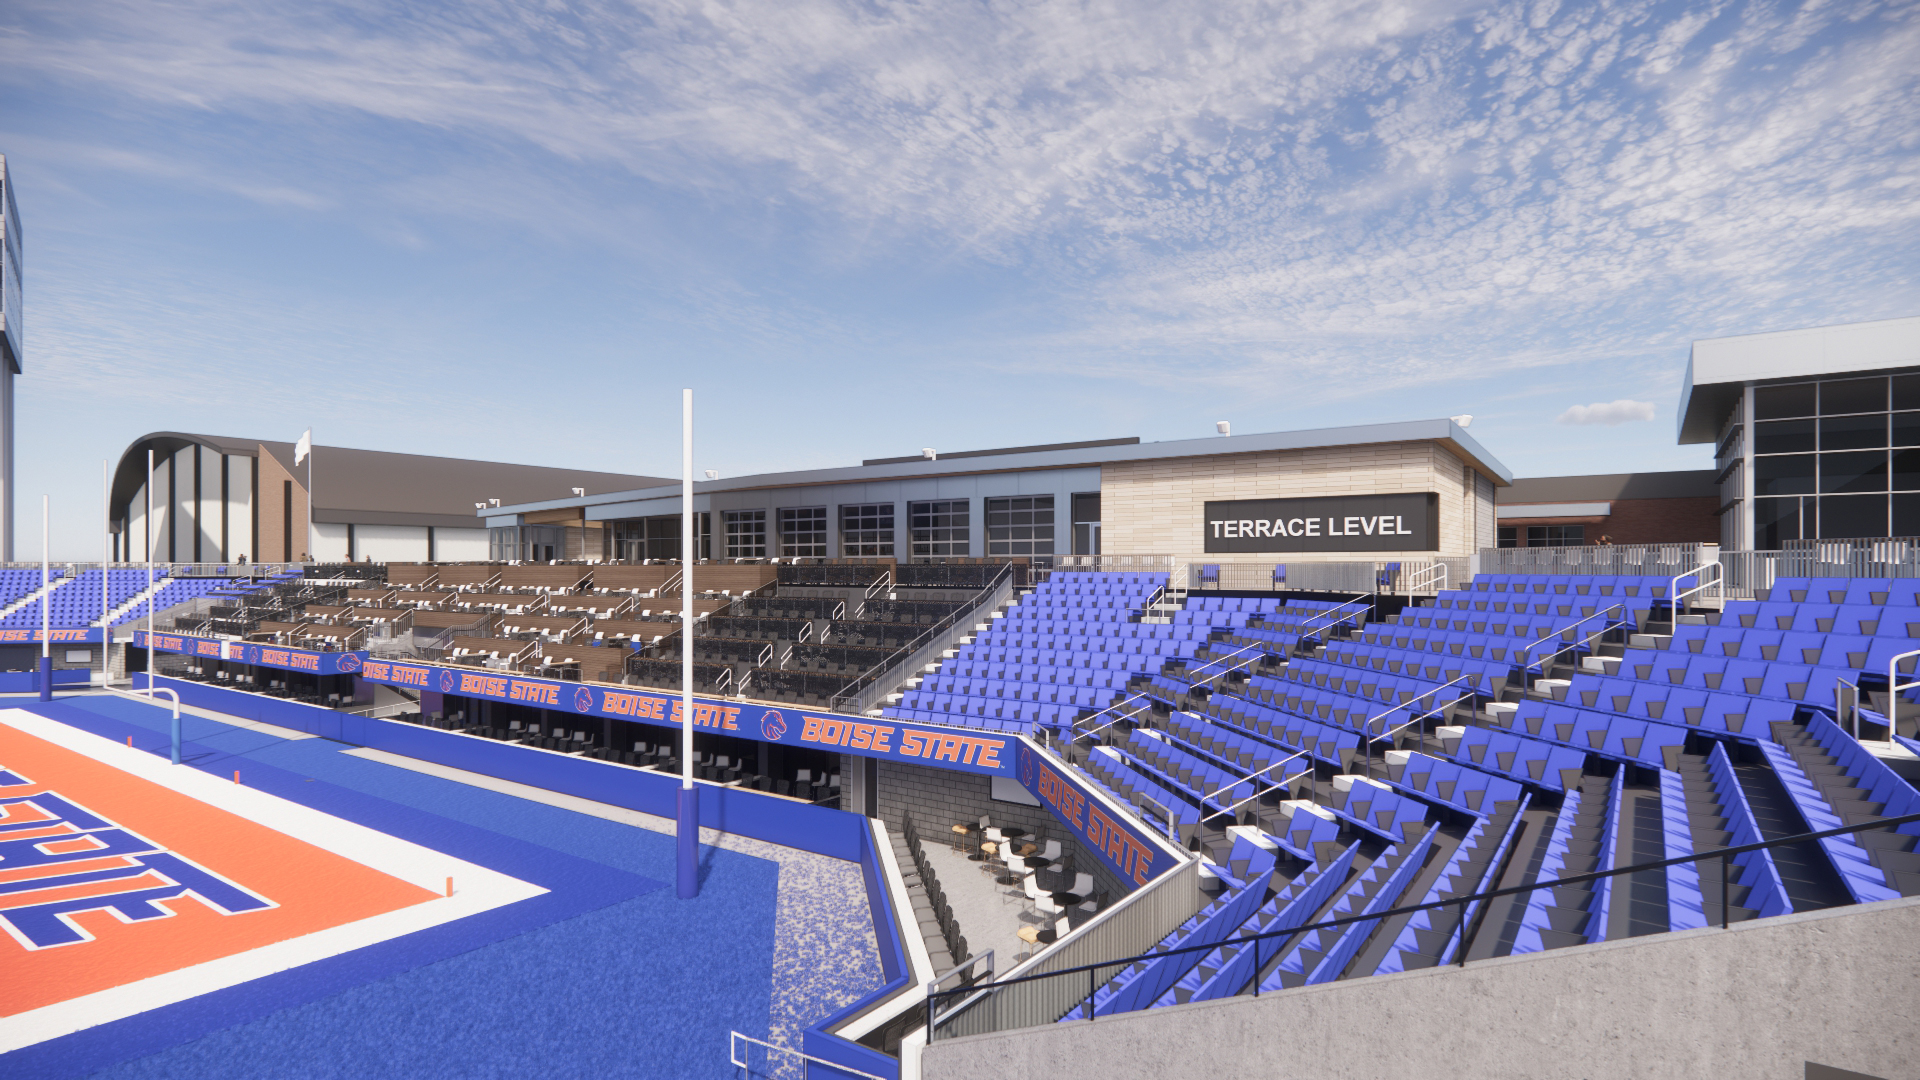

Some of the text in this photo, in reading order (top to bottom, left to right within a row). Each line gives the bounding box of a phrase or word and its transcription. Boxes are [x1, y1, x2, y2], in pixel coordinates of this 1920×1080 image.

[1210, 515, 1412, 539] TERRACE LEVEL
[261, 649, 320, 671] BOISE STATE
[391, 665, 430, 686] STATE
[460, 674, 561, 705] BOISE STATE
[602, 691, 741, 731] BOISE SATE
[801, 716, 1005, 769] BOISE STATE
[1038, 761, 1154, 887] BOISE STATE
